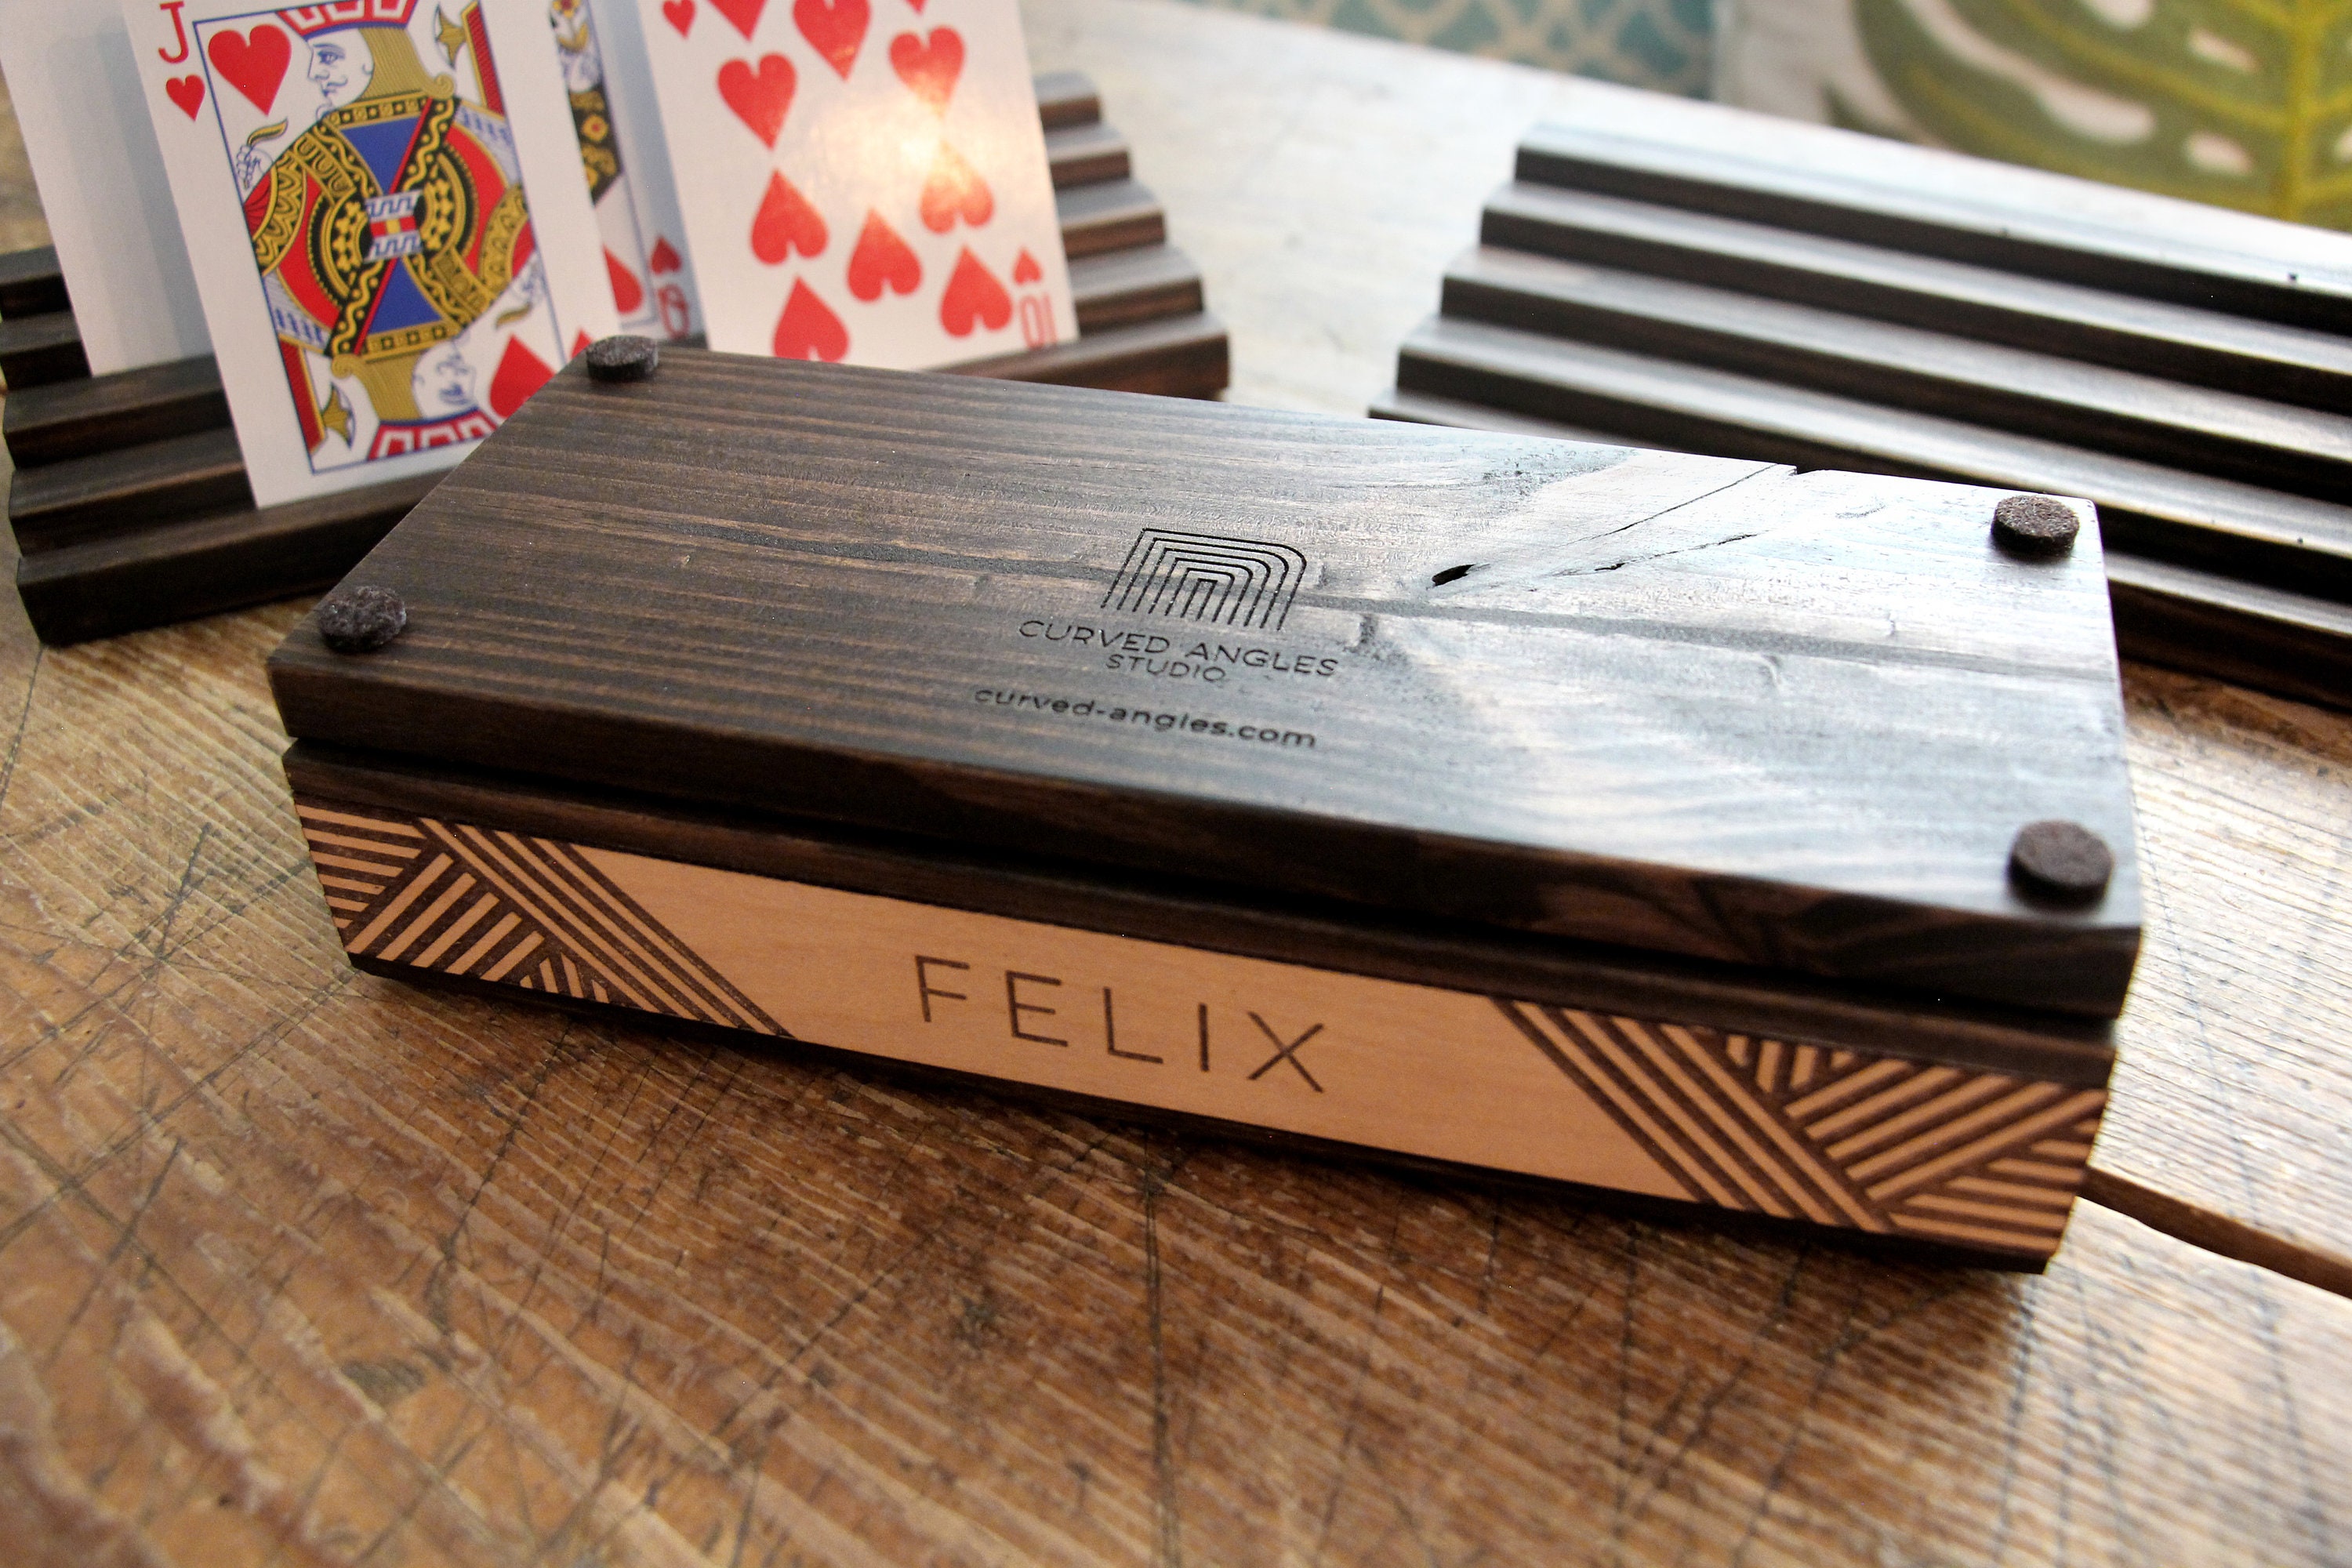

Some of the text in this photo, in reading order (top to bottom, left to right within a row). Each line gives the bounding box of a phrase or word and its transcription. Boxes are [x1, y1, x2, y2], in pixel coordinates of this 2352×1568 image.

[158, 1, 189, 64] J
[657, 285, 690, 339] Q
[1020, 292, 1057, 349] 10
[1019, 620, 1339, 677] CURVED ANGLES
[1105, 654, 1226, 683] STUDIO
[975, 688, 1317, 749] curved-angles.com
[915, 954, 1324, 1093] FELIX
